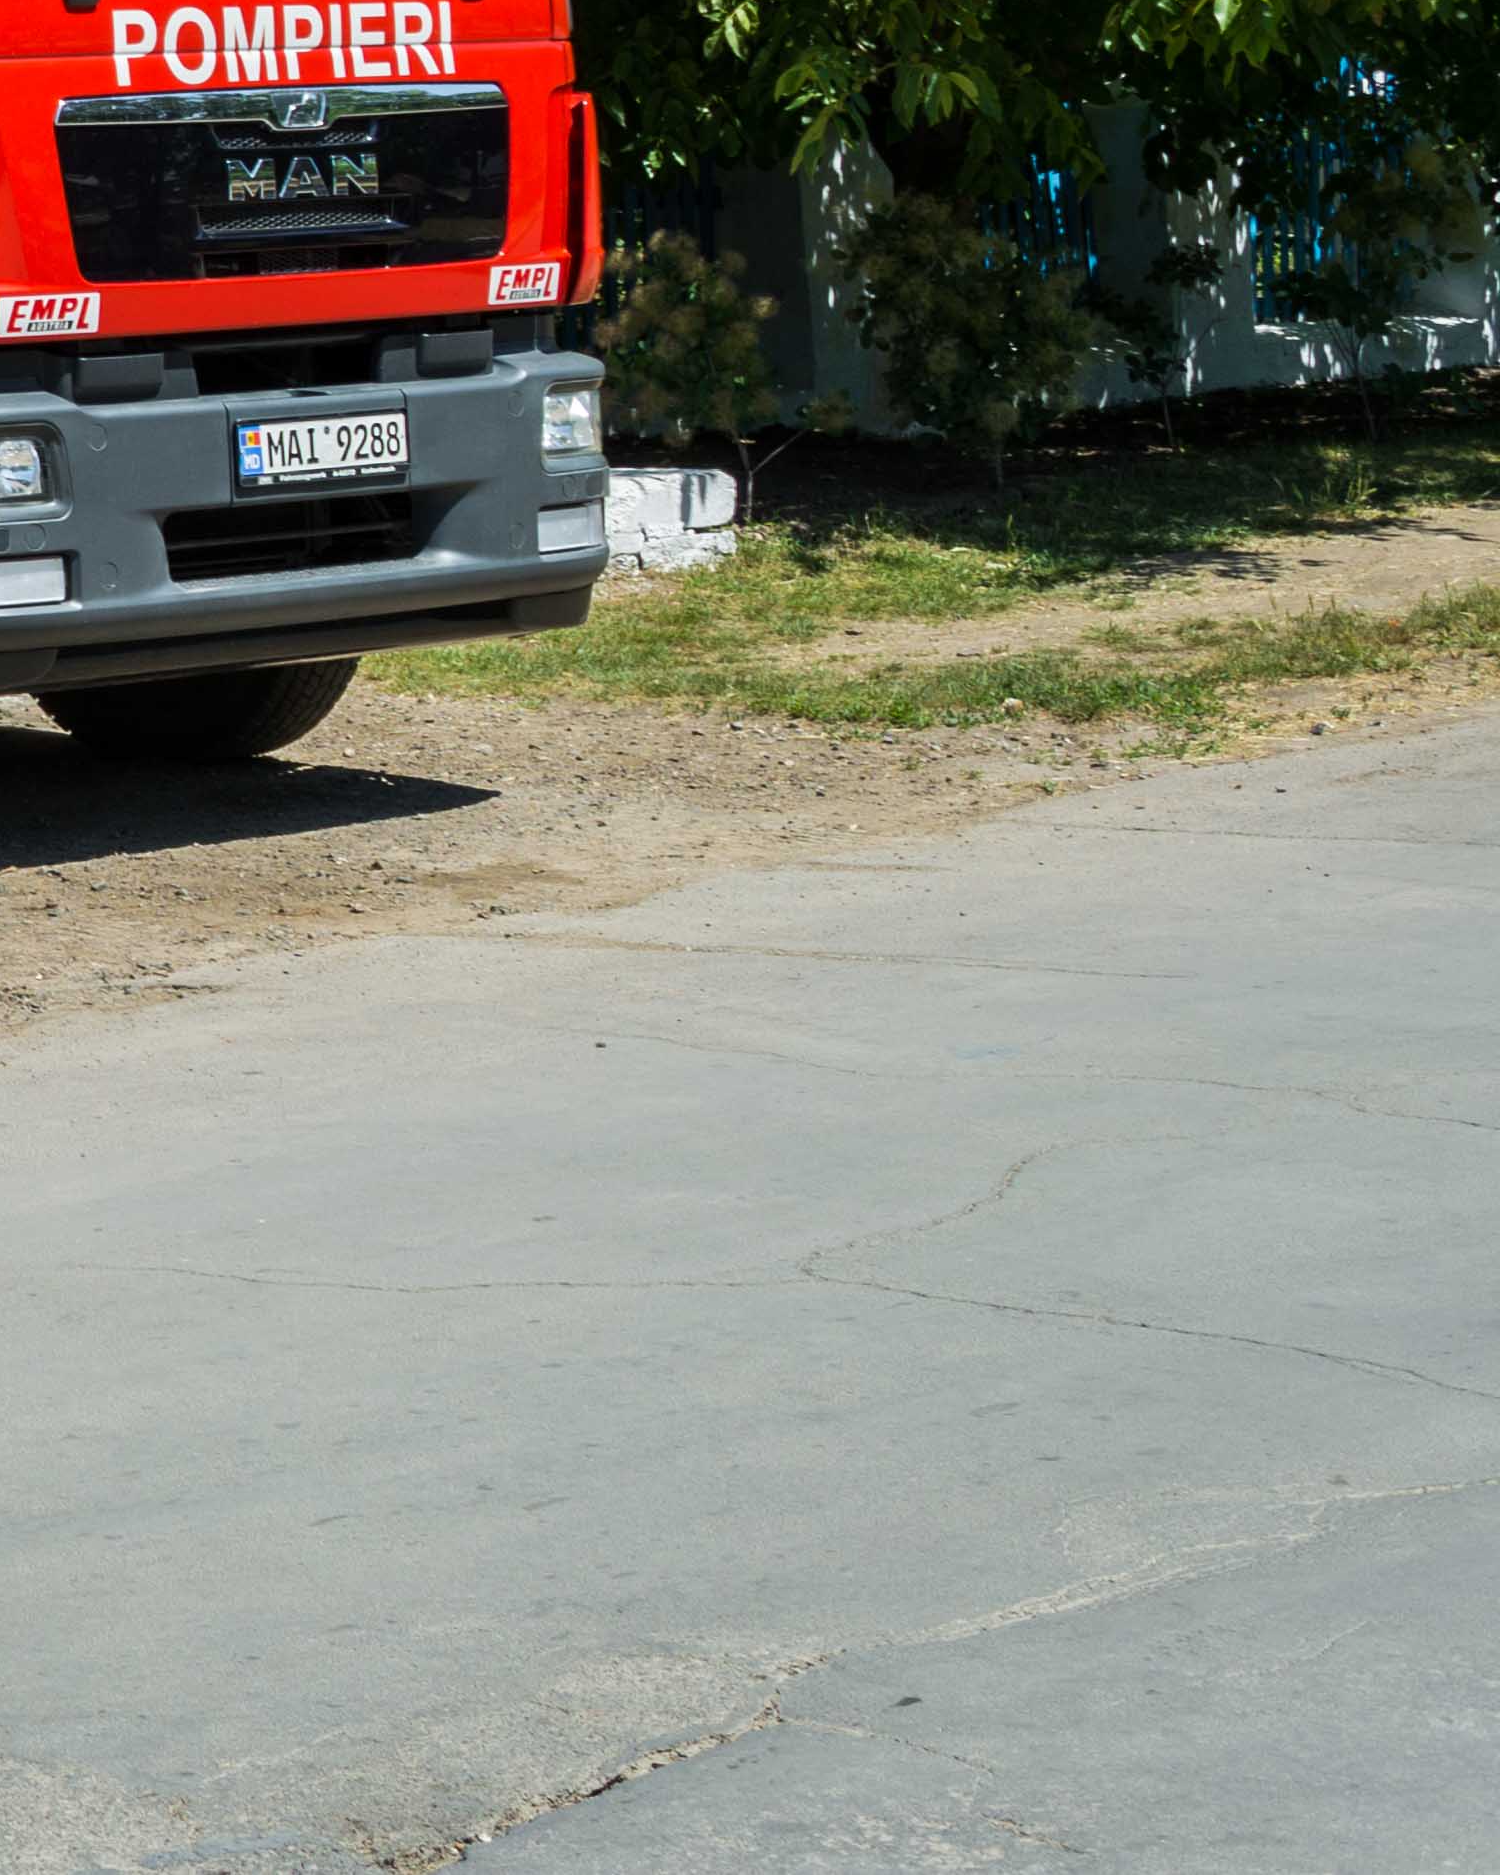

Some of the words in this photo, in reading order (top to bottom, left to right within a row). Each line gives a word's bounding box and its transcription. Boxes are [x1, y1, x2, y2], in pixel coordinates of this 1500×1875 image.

[111, 0, 456, 87] POMPIERI
[226, 153, 380, 202] MAN
[495, 266, 554, 301] EMPL
[6, 296, 90, 333] EMPL
[266, 427, 320, 468] MAI
[336, 421, 401, 462] 9288
